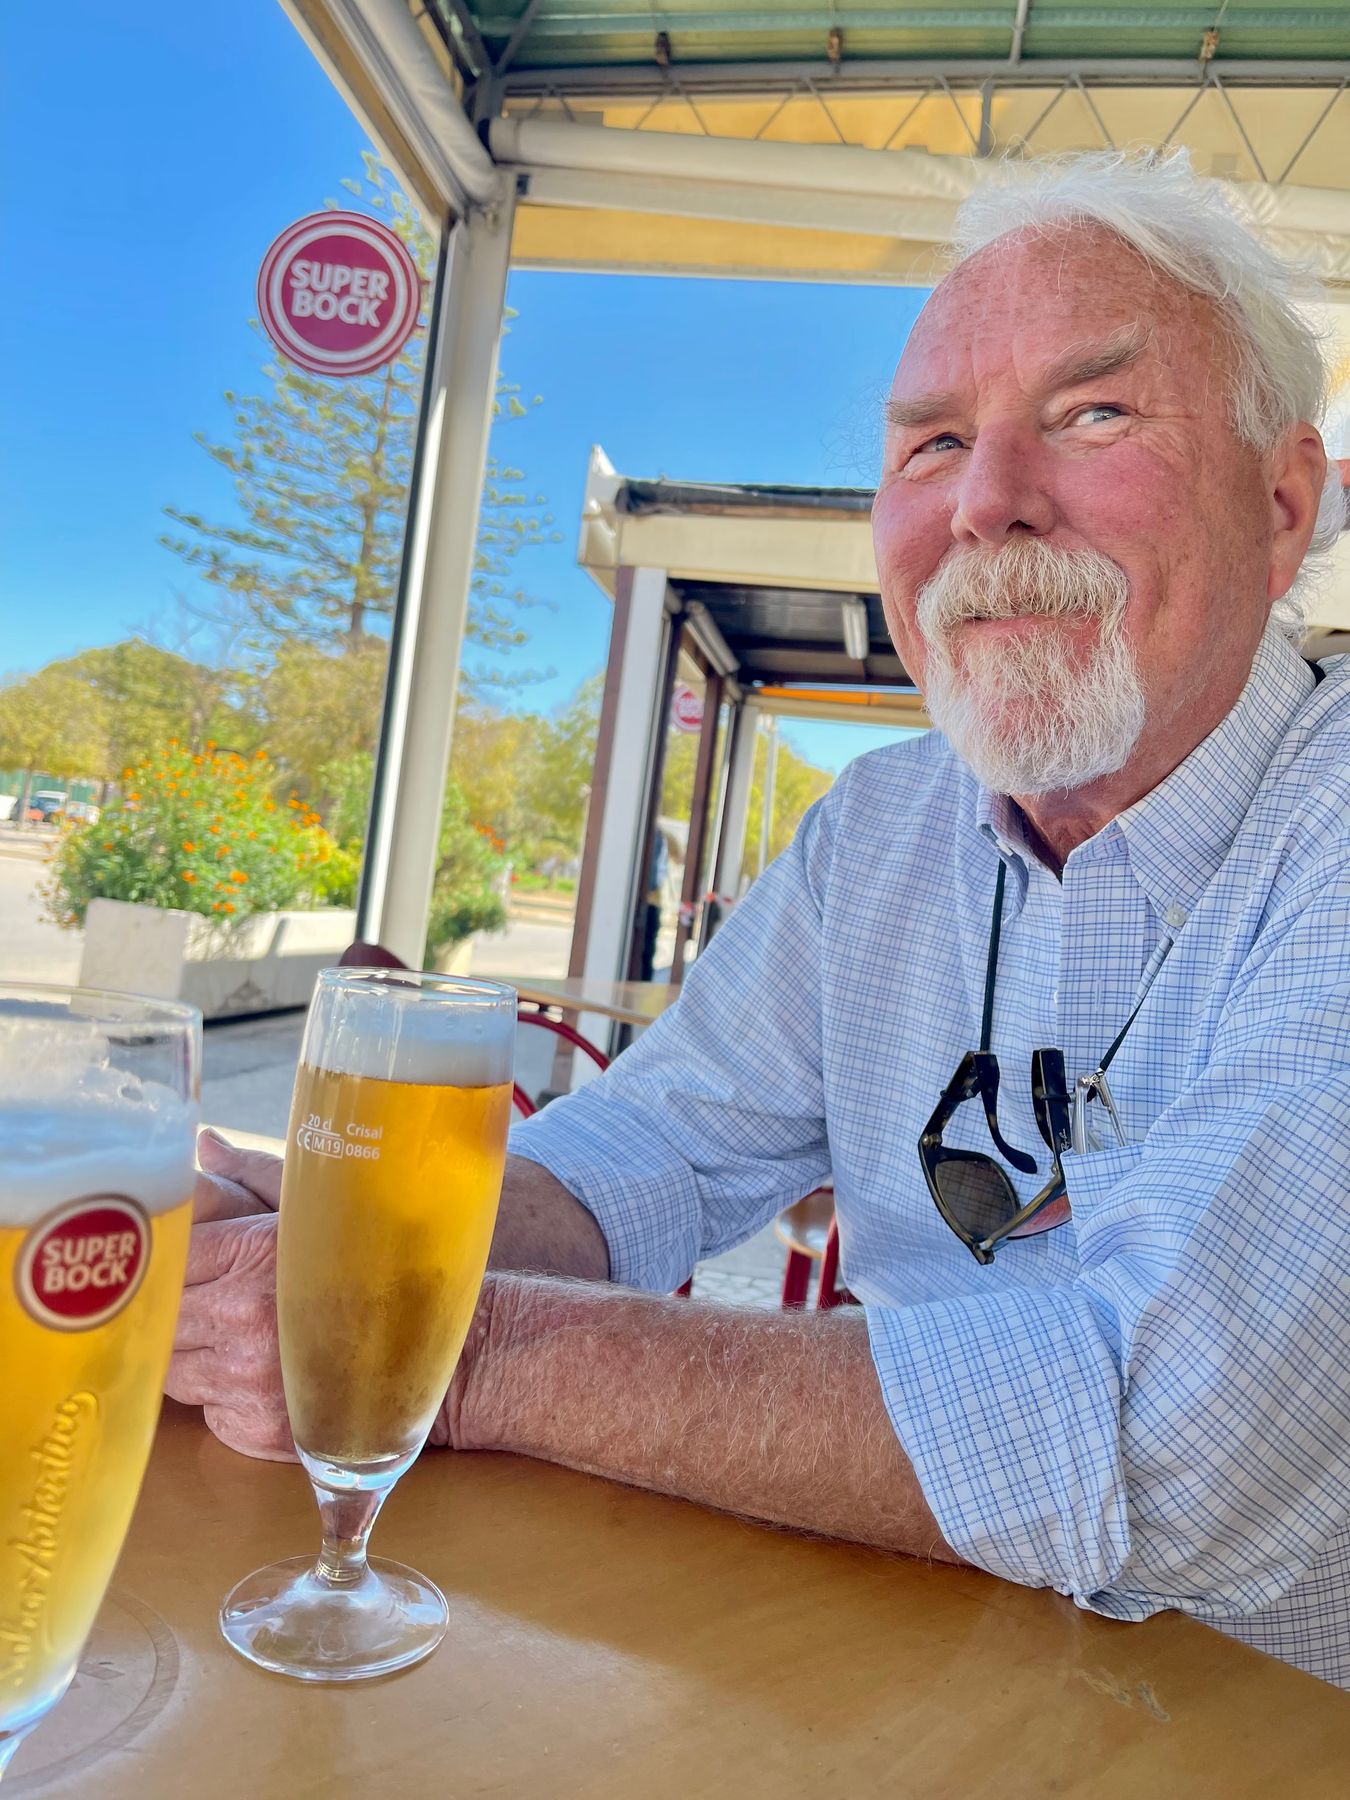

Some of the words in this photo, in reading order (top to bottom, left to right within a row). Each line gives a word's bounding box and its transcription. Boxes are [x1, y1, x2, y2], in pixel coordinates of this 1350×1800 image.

[289, 259, 389, 300] SUPER
[291, 288, 382, 328] BOCK
[308, 1113, 320, 1128] 20
[322, 1118, 332, 1131] cl
[346, 1122, 383, 1139] Crisal
[314, 1136, 341, 1153] M19
[345, 1143, 380, 1160] 0866
[42, 1231, 137, 1266] SUPER
[43, 1258, 127, 1294] BOCK
